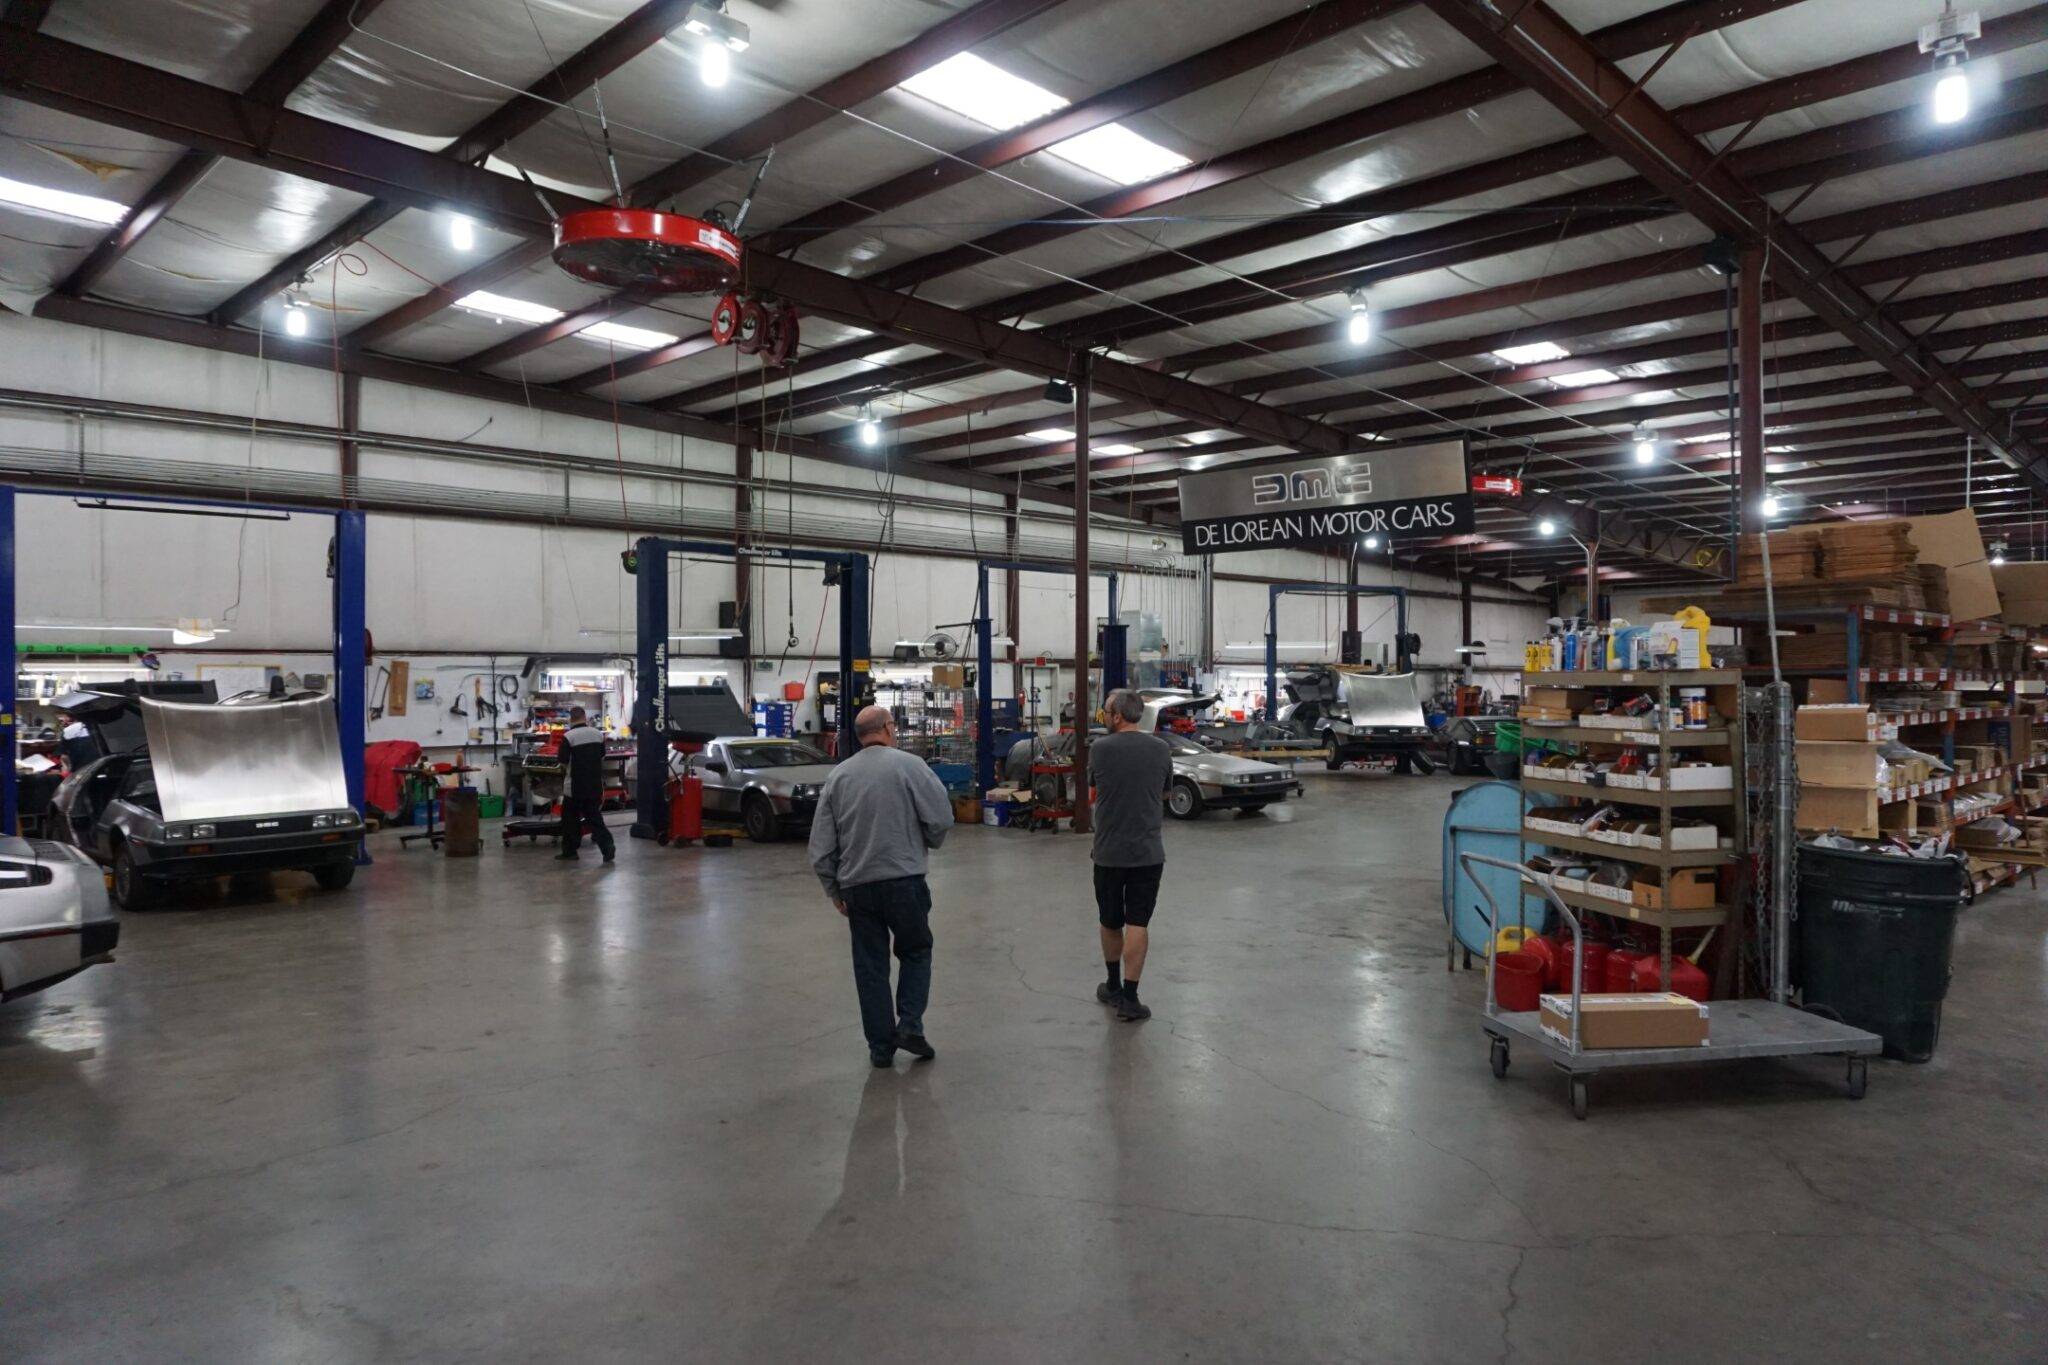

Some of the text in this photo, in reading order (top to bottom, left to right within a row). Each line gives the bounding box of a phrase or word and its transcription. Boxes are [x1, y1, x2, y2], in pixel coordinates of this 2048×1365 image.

[1253, 462, 1372, 505] DMC
[1195, 502, 1455, 547] DE LOREAN MOTOR CARS
[653, 643, 667, 733] Challenger Lifts
